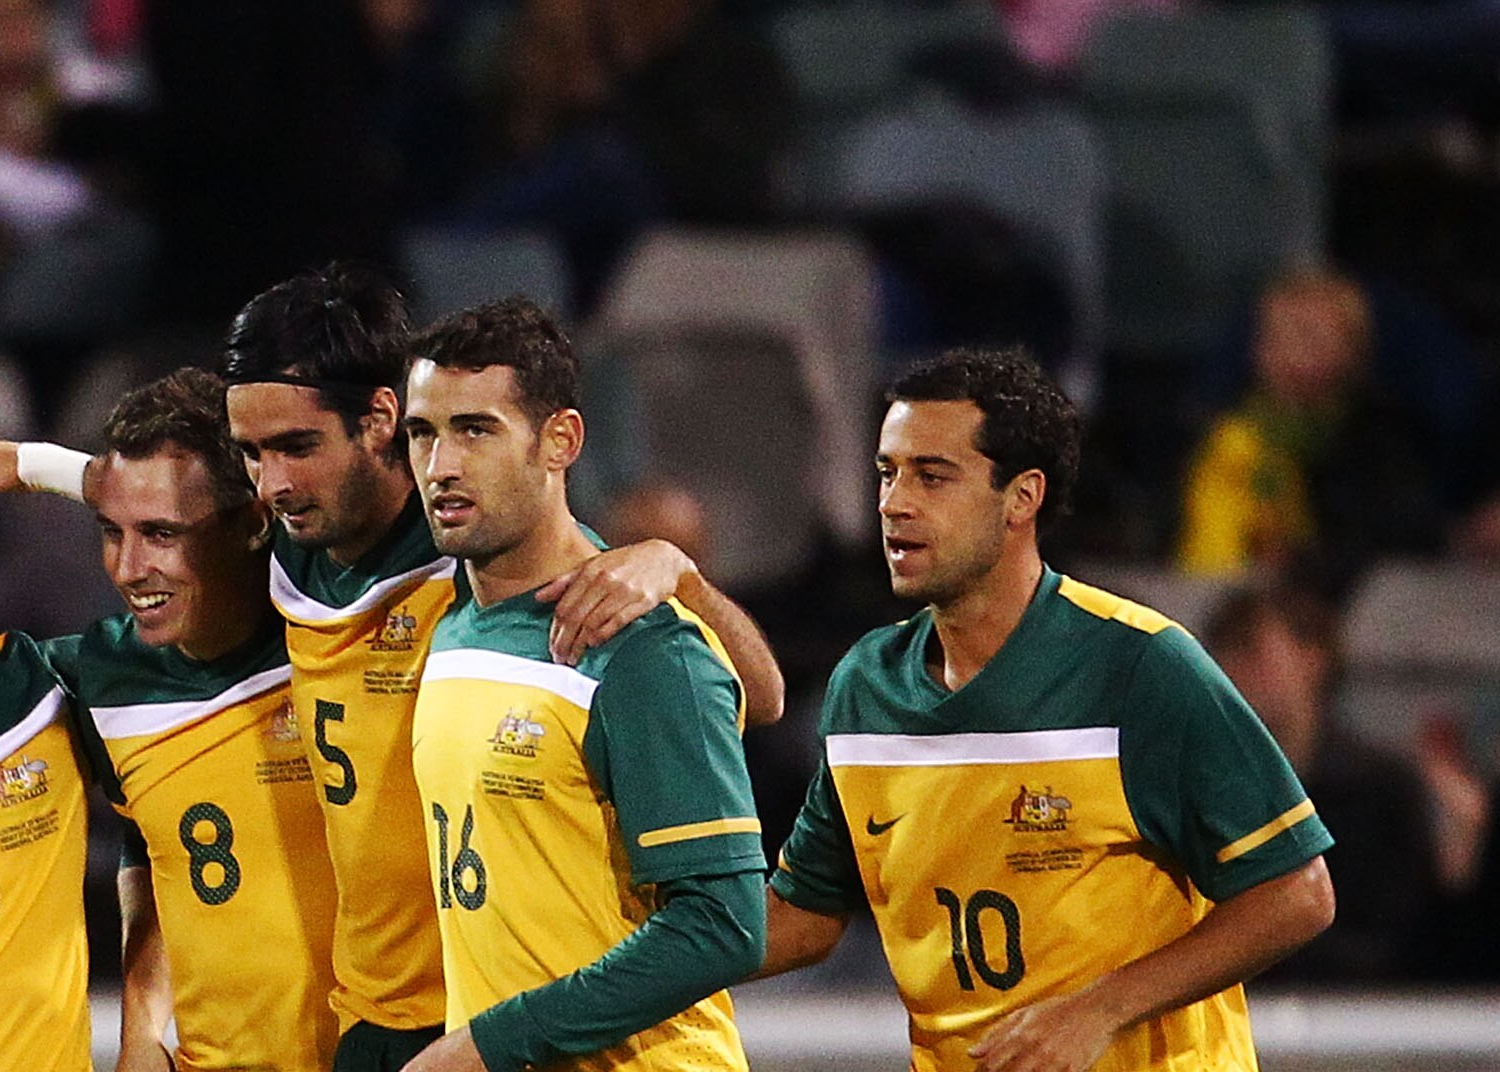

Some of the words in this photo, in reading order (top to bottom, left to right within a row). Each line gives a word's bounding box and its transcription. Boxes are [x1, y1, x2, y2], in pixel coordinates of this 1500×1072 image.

[315, 698, 357, 806] 5
[179, 802, 240, 905] 8
[433, 801, 486, 911] 16
[934, 887, 1025, 992] 10
